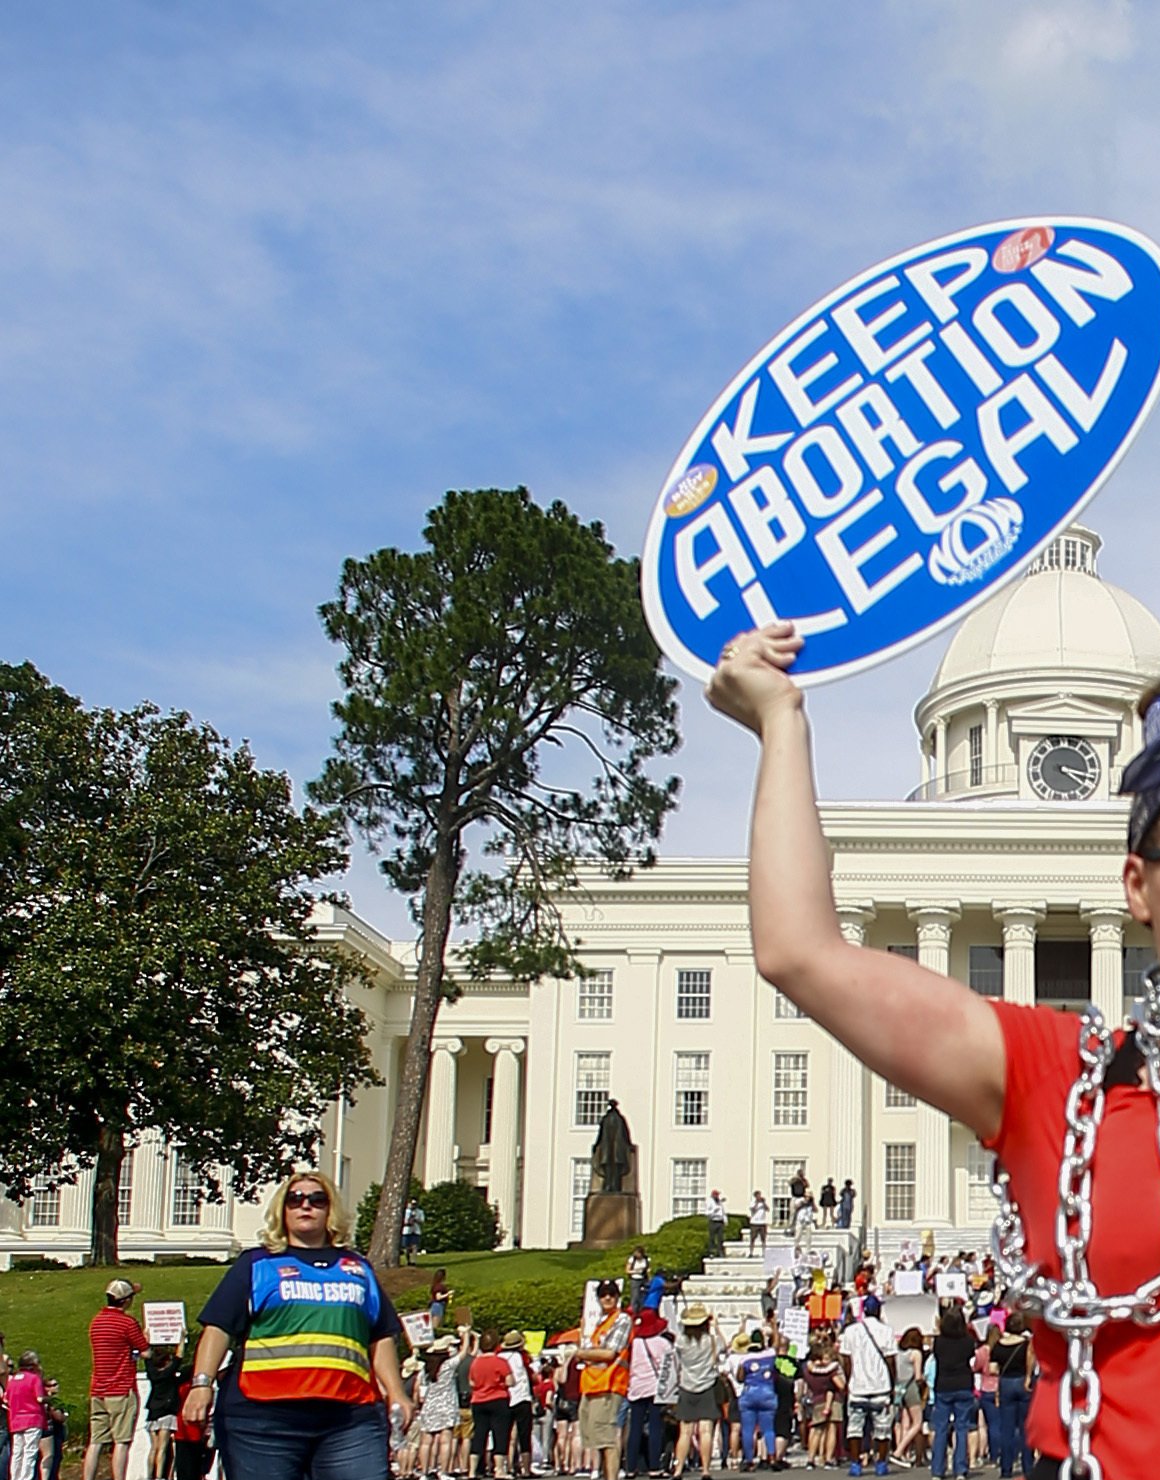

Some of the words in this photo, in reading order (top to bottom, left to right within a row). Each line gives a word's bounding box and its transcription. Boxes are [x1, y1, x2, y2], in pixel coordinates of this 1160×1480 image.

[674, 239, 1134, 621] ABORTION
[711, 246, 989, 483] KEEP
[741, 337, 1128, 638] LEGAL
[928, 497, 1024, 585] NOW
[280, 1281, 322, 1301] CLINIC
[323, 1282, 366, 1306] ESCOR
